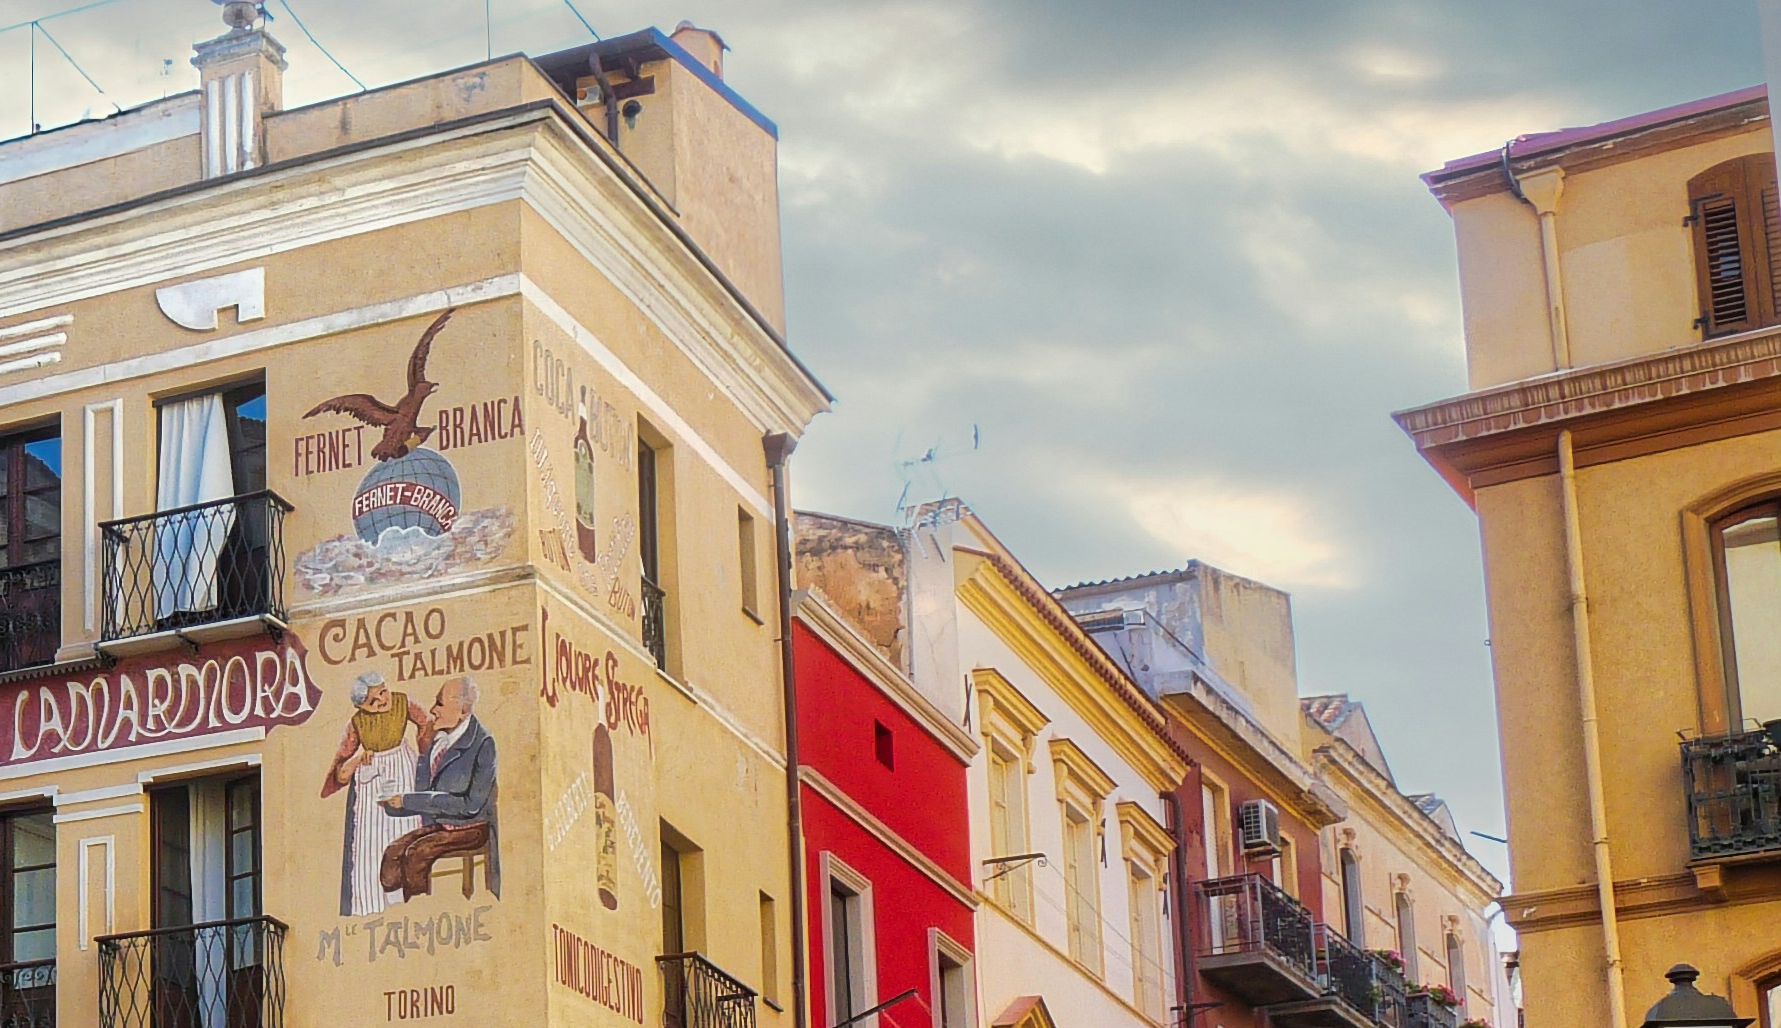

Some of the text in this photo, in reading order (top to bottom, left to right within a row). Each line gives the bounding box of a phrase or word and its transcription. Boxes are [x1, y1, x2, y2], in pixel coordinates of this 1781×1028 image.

[533, 339, 575, 425] COCA
[294, 396, 526, 477] FERNET BRANCA
[319, 607, 447, 666] CACAO
[390, 623, 532, 682] TALMONE
[10, 645, 314, 762] LAMARMORA
[539, 604, 654, 761] LIQUORE STREGA
[363, 904, 493, 963] TALMONE
[383, 984, 456, 1022] TORINO
